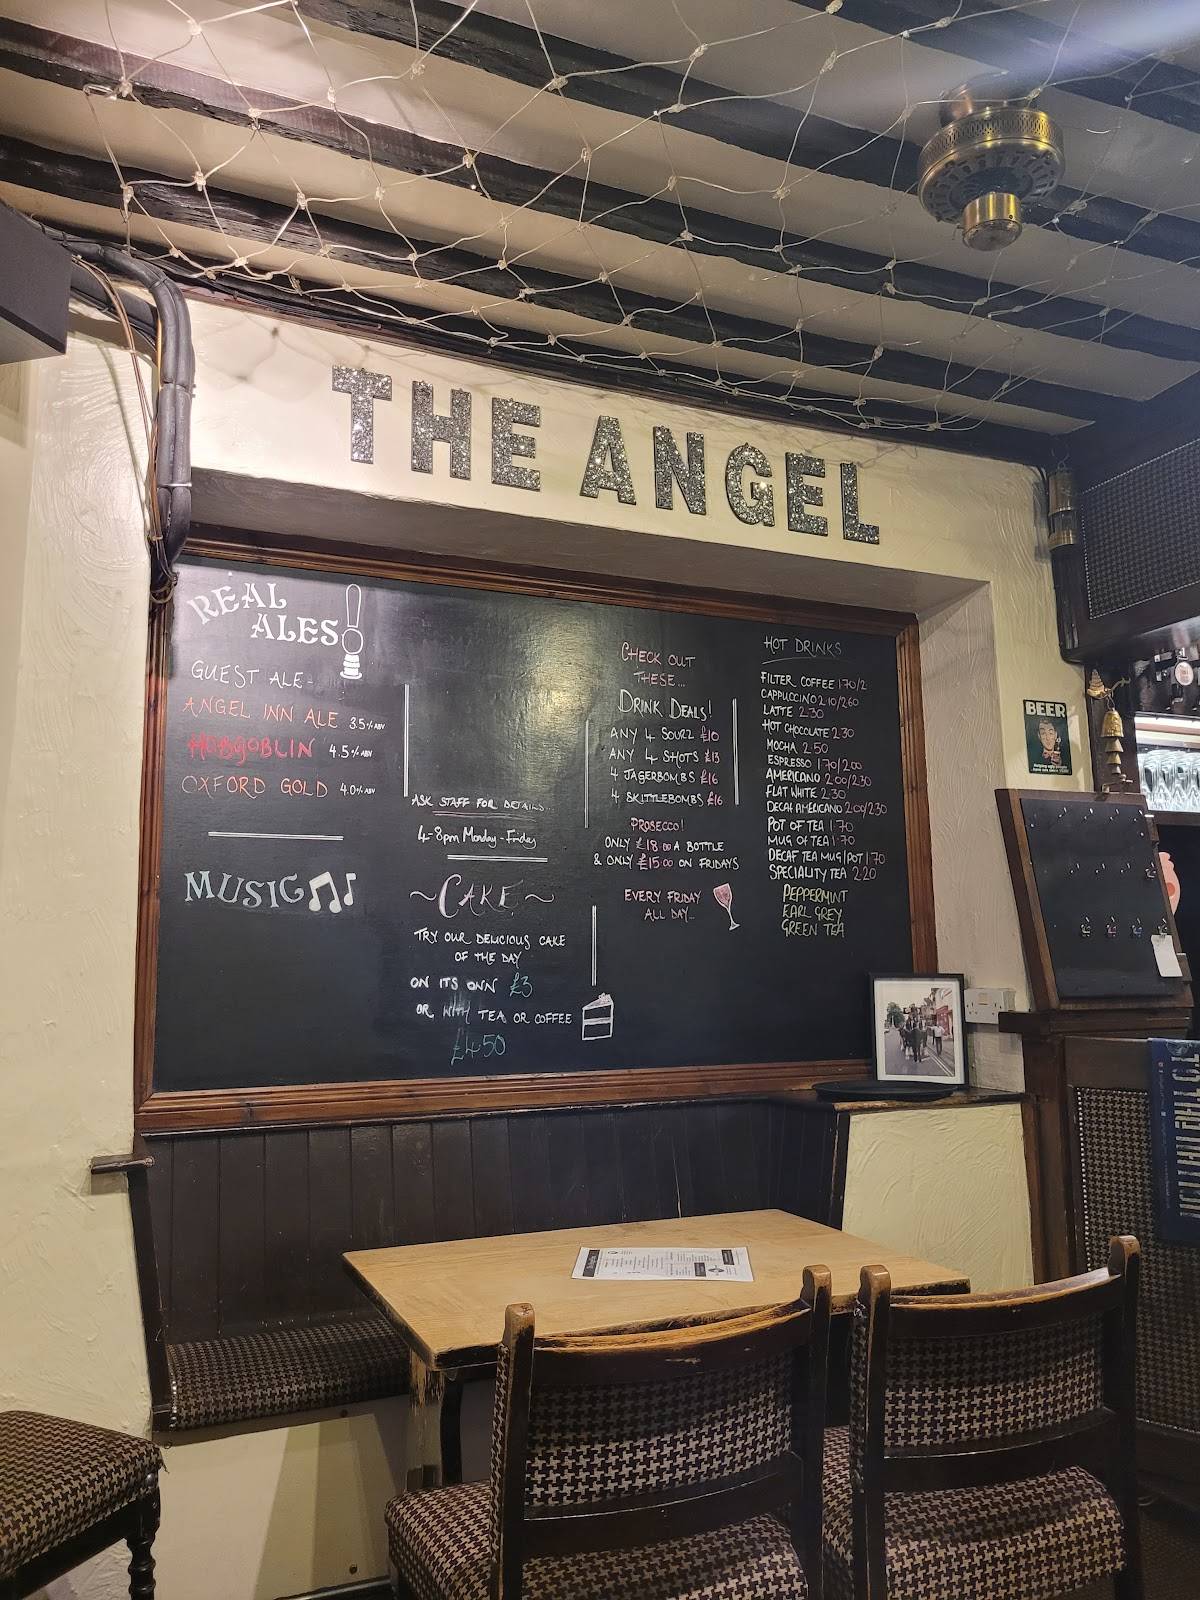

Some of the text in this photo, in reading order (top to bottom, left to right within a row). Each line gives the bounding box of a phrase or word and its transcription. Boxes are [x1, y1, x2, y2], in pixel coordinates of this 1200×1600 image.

[332, 364, 880, 544] THE ANGEL
[187, 582, 286, 625] REAL
[251, 613, 339, 646] ALES
[622, 642, 696, 668] CHECK OUT
[764, 636, 842, 658] HOT DRINKS
[192, 660, 259, 688] GUEST
[761, 672, 797, 688] FILTER
[800, 676, 835, 690] COFFEE
[618, 689, 712, 722] DRINK DEALS!
[761, 689, 816, 704] CAPPUCCINO
[182, 696, 251, 718] ANGEL
[264, 704, 294, 722] INN
[304, 708, 338, 728] ALE
[764, 704, 792, 717] LATTE
[1025, 702, 1066, 718] BEER
[610, 726, 720, 744] ANY 4 SOURZ £10
[762, 720, 782, 735] HOT
[784, 723, 830, 738] CHOCOLATE
[766, 738, 828, 754] MOCHA 2.50
[609, 748, 634, 762] ANY
[646, 748, 658, 764] 4
[663, 750, 698, 768] SHOTS
[768, 755, 812, 768] ESPRESSO
[610, 767, 718, 785] 4 JAGERBOMBS £16
[766, 768, 820, 783] AMERICANO
[182, 775, 266, 799] OXFORD
[280, 776, 328, 798] GOLD
[766, 784, 846, 800] FLAT WHITE 2.30
[412, 794, 434, 806] ASK
[439, 796, 470, 808] STAFF
[476, 798, 498, 810] FOR
[612, 788, 723, 806] 4 SKITTLEBOMBS £16
[796, 802, 842, 814] AMERICANO
[630, 818, 684, 832] PROSECCO!
[768, 816, 786, 832] POT
[790, 820, 805, 832] OF
[807, 820, 824, 832] TEA
[418, 825, 460, 844] 4-8pm
[462, 826, 497, 848] Monday
[506, 829, 536, 849] Friday
[605, 836, 630, 851] ONLY
[674, 842, 680, 851] A
[686, 842, 724, 852] BOTTLE
[768, 835, 792, 846] MUG
[810, 836, 829, 847] TEA
[594, 854, 602, 866] &
[606, 854, 634, 869] ONLY
[679, 858, 692, 868] ON
[699, 857, 740, 870] FRIDAYS
[768, 848, 799, 862] DECAF
[802, 851, 818, 863] TEA
[769, 864, 827, 882] SPECIALITY
[830, 867, 847, 880] TEA
[184, 870, 304, 908] MUSIC
[438, 874, 524, 918] CAKE
[624, 889, 702, 905] EVERY FRIDAY
[783, 884, 848, 904] PEPPERMINT
[644, 908, 665, 922] ALL
[783, 904, 842, 924] EARL GREY
[782, 919, 844, 938] GREEN TEA
[414, 927, 566, 950] TRY OUR DELICIOUS CAKE
[454, 952, 522, 968] OF THE DAY
[410, 976, 430, 988] ON
[440, 978, 458, 990] ITS
[510, 972, 533, 998] £3
[416, 1004, 434, 1018] OR
[478, 1010, 506, 1024] TEA
[514, 1014, 530, 1024] OR
[534, 1014, 572, 1024] COFFEE
